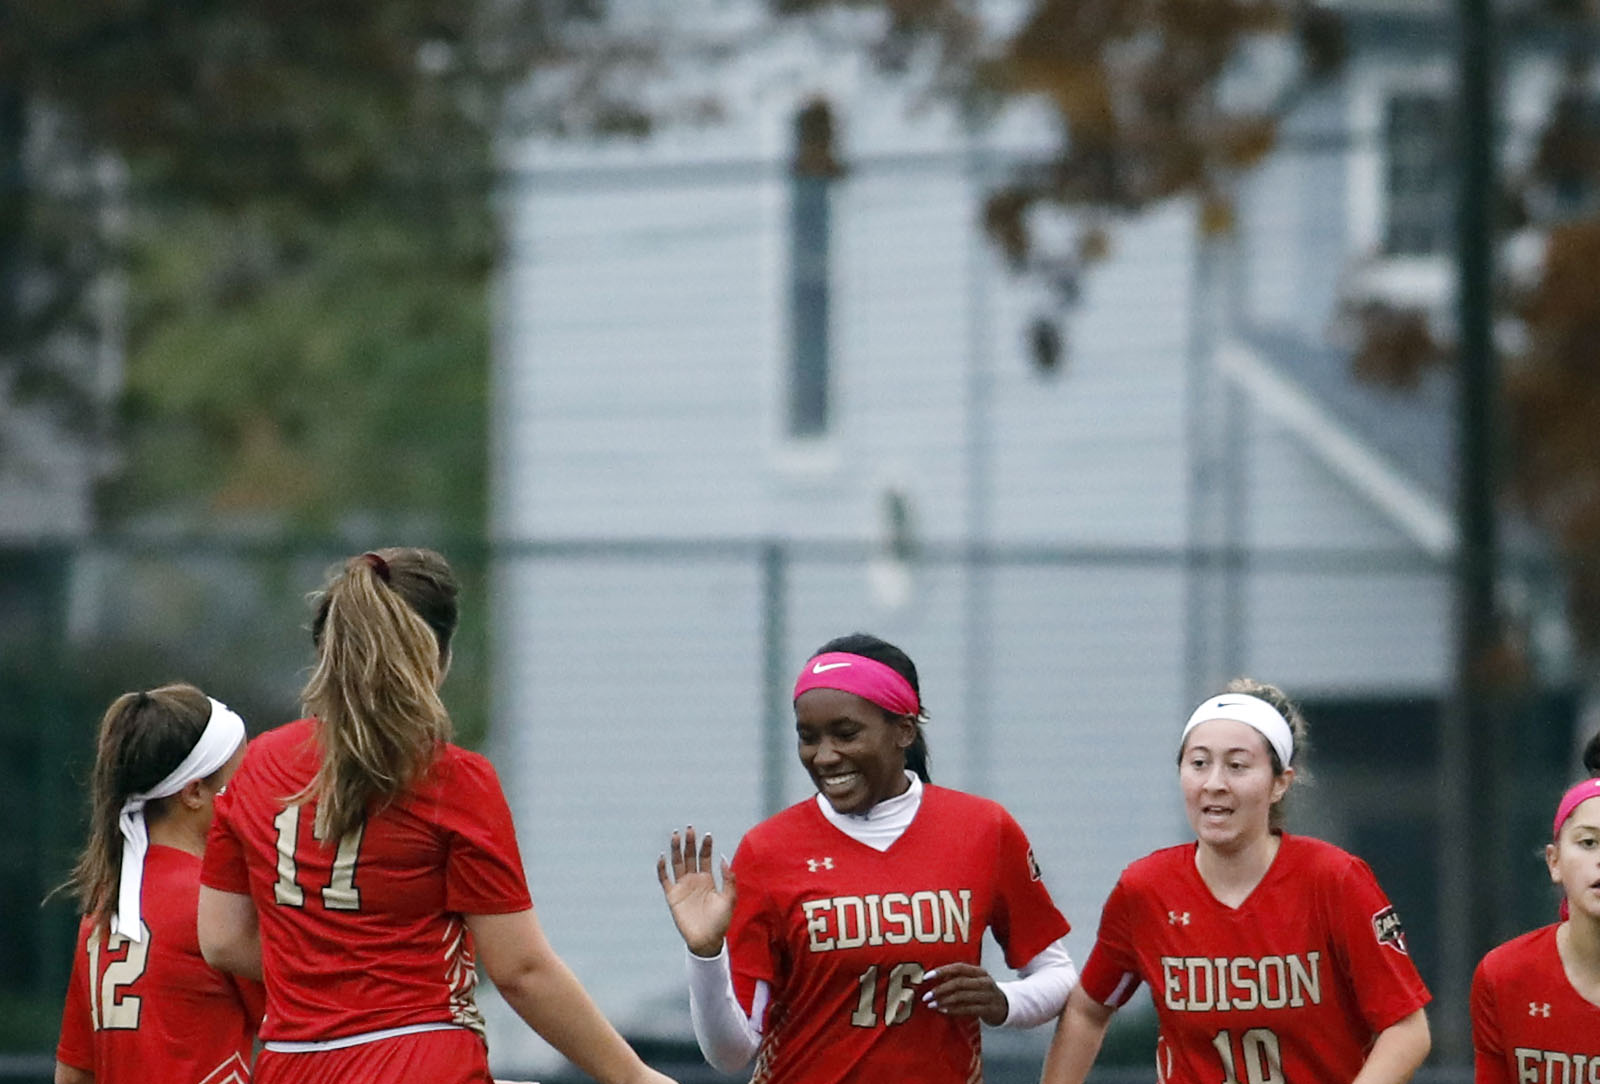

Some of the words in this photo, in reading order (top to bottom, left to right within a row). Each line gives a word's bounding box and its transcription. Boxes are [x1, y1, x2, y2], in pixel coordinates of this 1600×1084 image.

[273, 802, 366, 910] 17
[802, 890, 972, 952] EDISON
[86, 919, 152, 1032] 12
[851, 961, 926, 1028] 16
[1161, 951, 1321, 1012] EDISON
